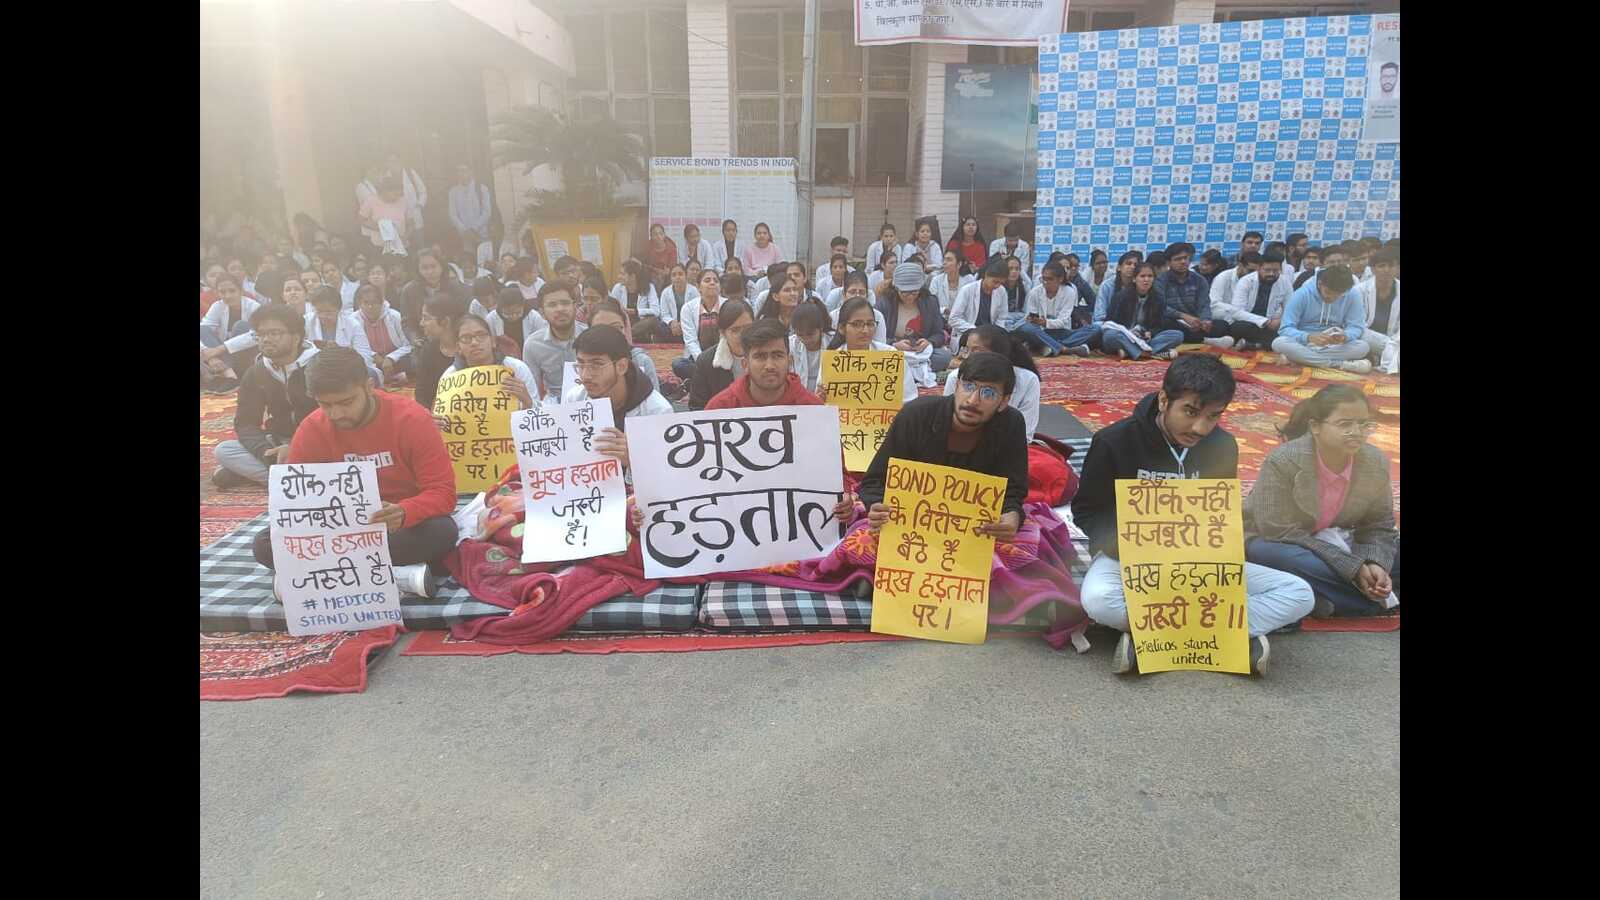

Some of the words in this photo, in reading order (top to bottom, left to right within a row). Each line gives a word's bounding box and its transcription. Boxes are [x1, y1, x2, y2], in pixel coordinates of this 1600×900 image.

[1377, 21, 1400, 31] RES
[655, 158, 694, 167] SERVICE
[695, 158, 721, 167] BOND
[724, 158, 758, 167] TRENDS
[761, 159, 769, 167] IN
[772, 158, 794, 167] INDIA
[438, 373, 467, 394] BOND
[470, 369, 513, 387] POLIC
[826, 374, 881, 405] मजबूरी
[664, 414, 797, 482] भूख
[465, 464, 487, 480] पर
[887, 464, 937, 496] BOND
[942, 474, 1006, 512] POLICY
[276, 495, 350, 530] मजबूरी
[889, 495, 907, 526] के
[645, 488, 844, 569] हड़ताल
[1120, 513, 1201, 549] मजबूरी
[874, 567, 916, 598] भूख
[918, 572, 986, 604] हड़ताल
[1123, 562, 1163, 595] भूख
[1169, 561, 1244, 594] हड़ताल
[324, 592, 386, 609] MEDICOS
[911, 603, 939, 629] पर
[300, 615, 350, 628] STAND
[353, 611, 402, 625] UNITED
[1183, 634, 1219, 650] stand
